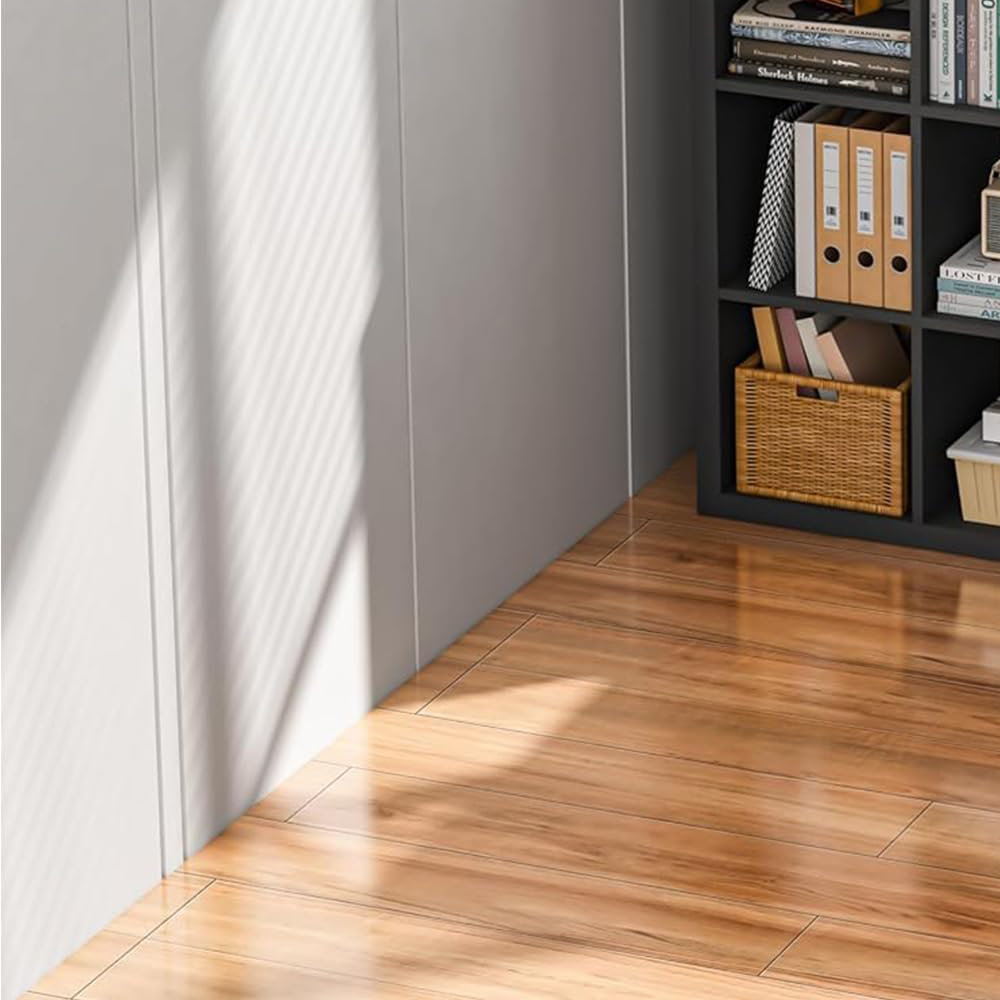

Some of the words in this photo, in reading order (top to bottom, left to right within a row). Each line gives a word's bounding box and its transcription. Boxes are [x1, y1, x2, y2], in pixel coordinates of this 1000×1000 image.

[757, 66, 795, 82] Sherlock
[797, 70, 828, 85] Holmes
[945, 269, 985, 282] LOST
